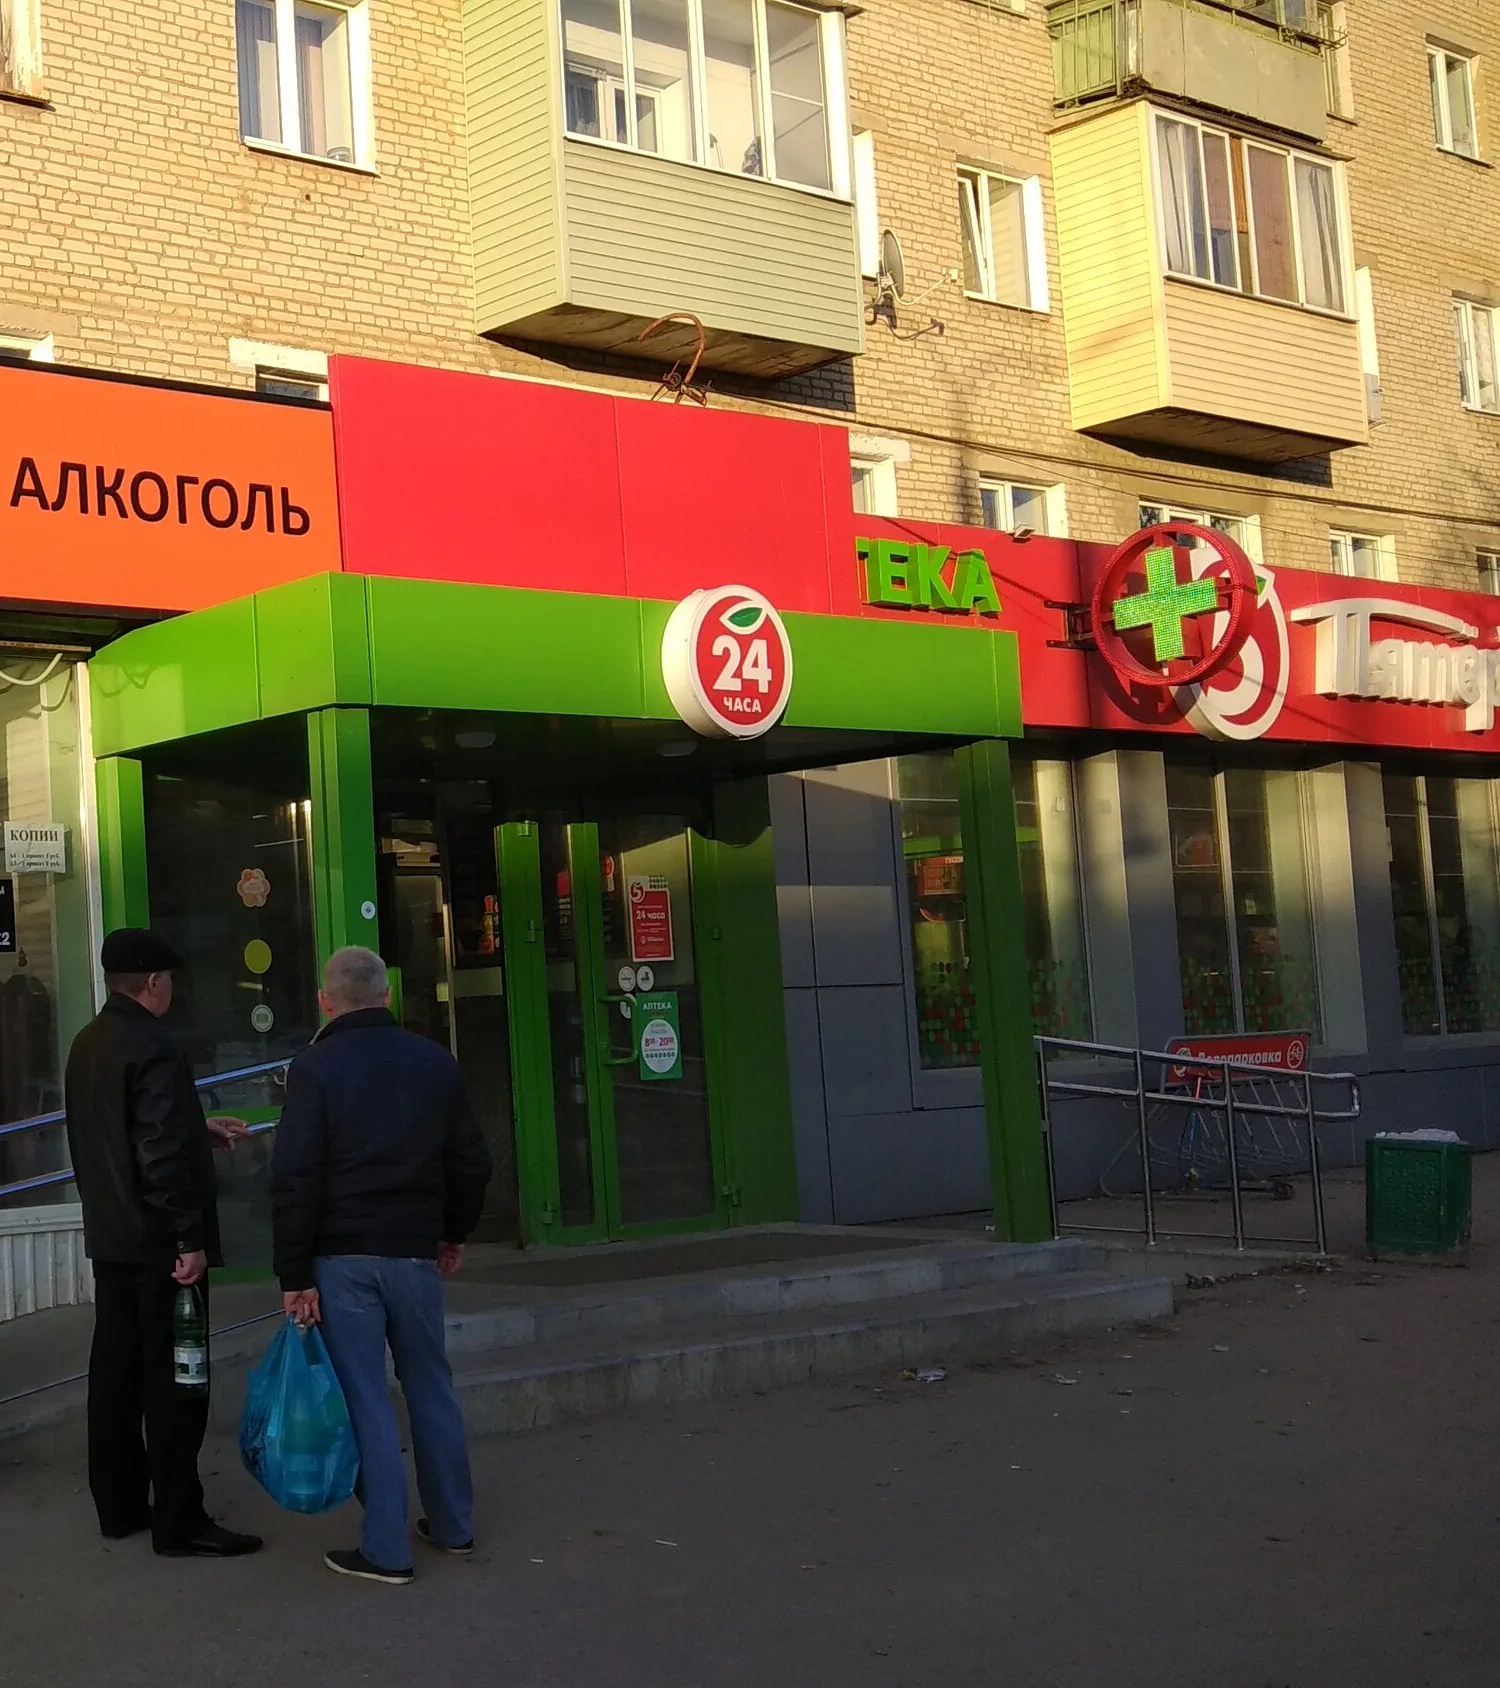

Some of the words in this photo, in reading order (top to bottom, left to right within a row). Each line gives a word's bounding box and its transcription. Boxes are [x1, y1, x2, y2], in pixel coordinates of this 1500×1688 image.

[9, 456, 311, 536] АЛКОГОЛЬ
[712, 634, 772, 694] 24
[723, 696, 762, 713] ЧАСА
[10, 830, 58, 841] КОПИИ
[643, 1002, 672, 1011] АПТЕКА
